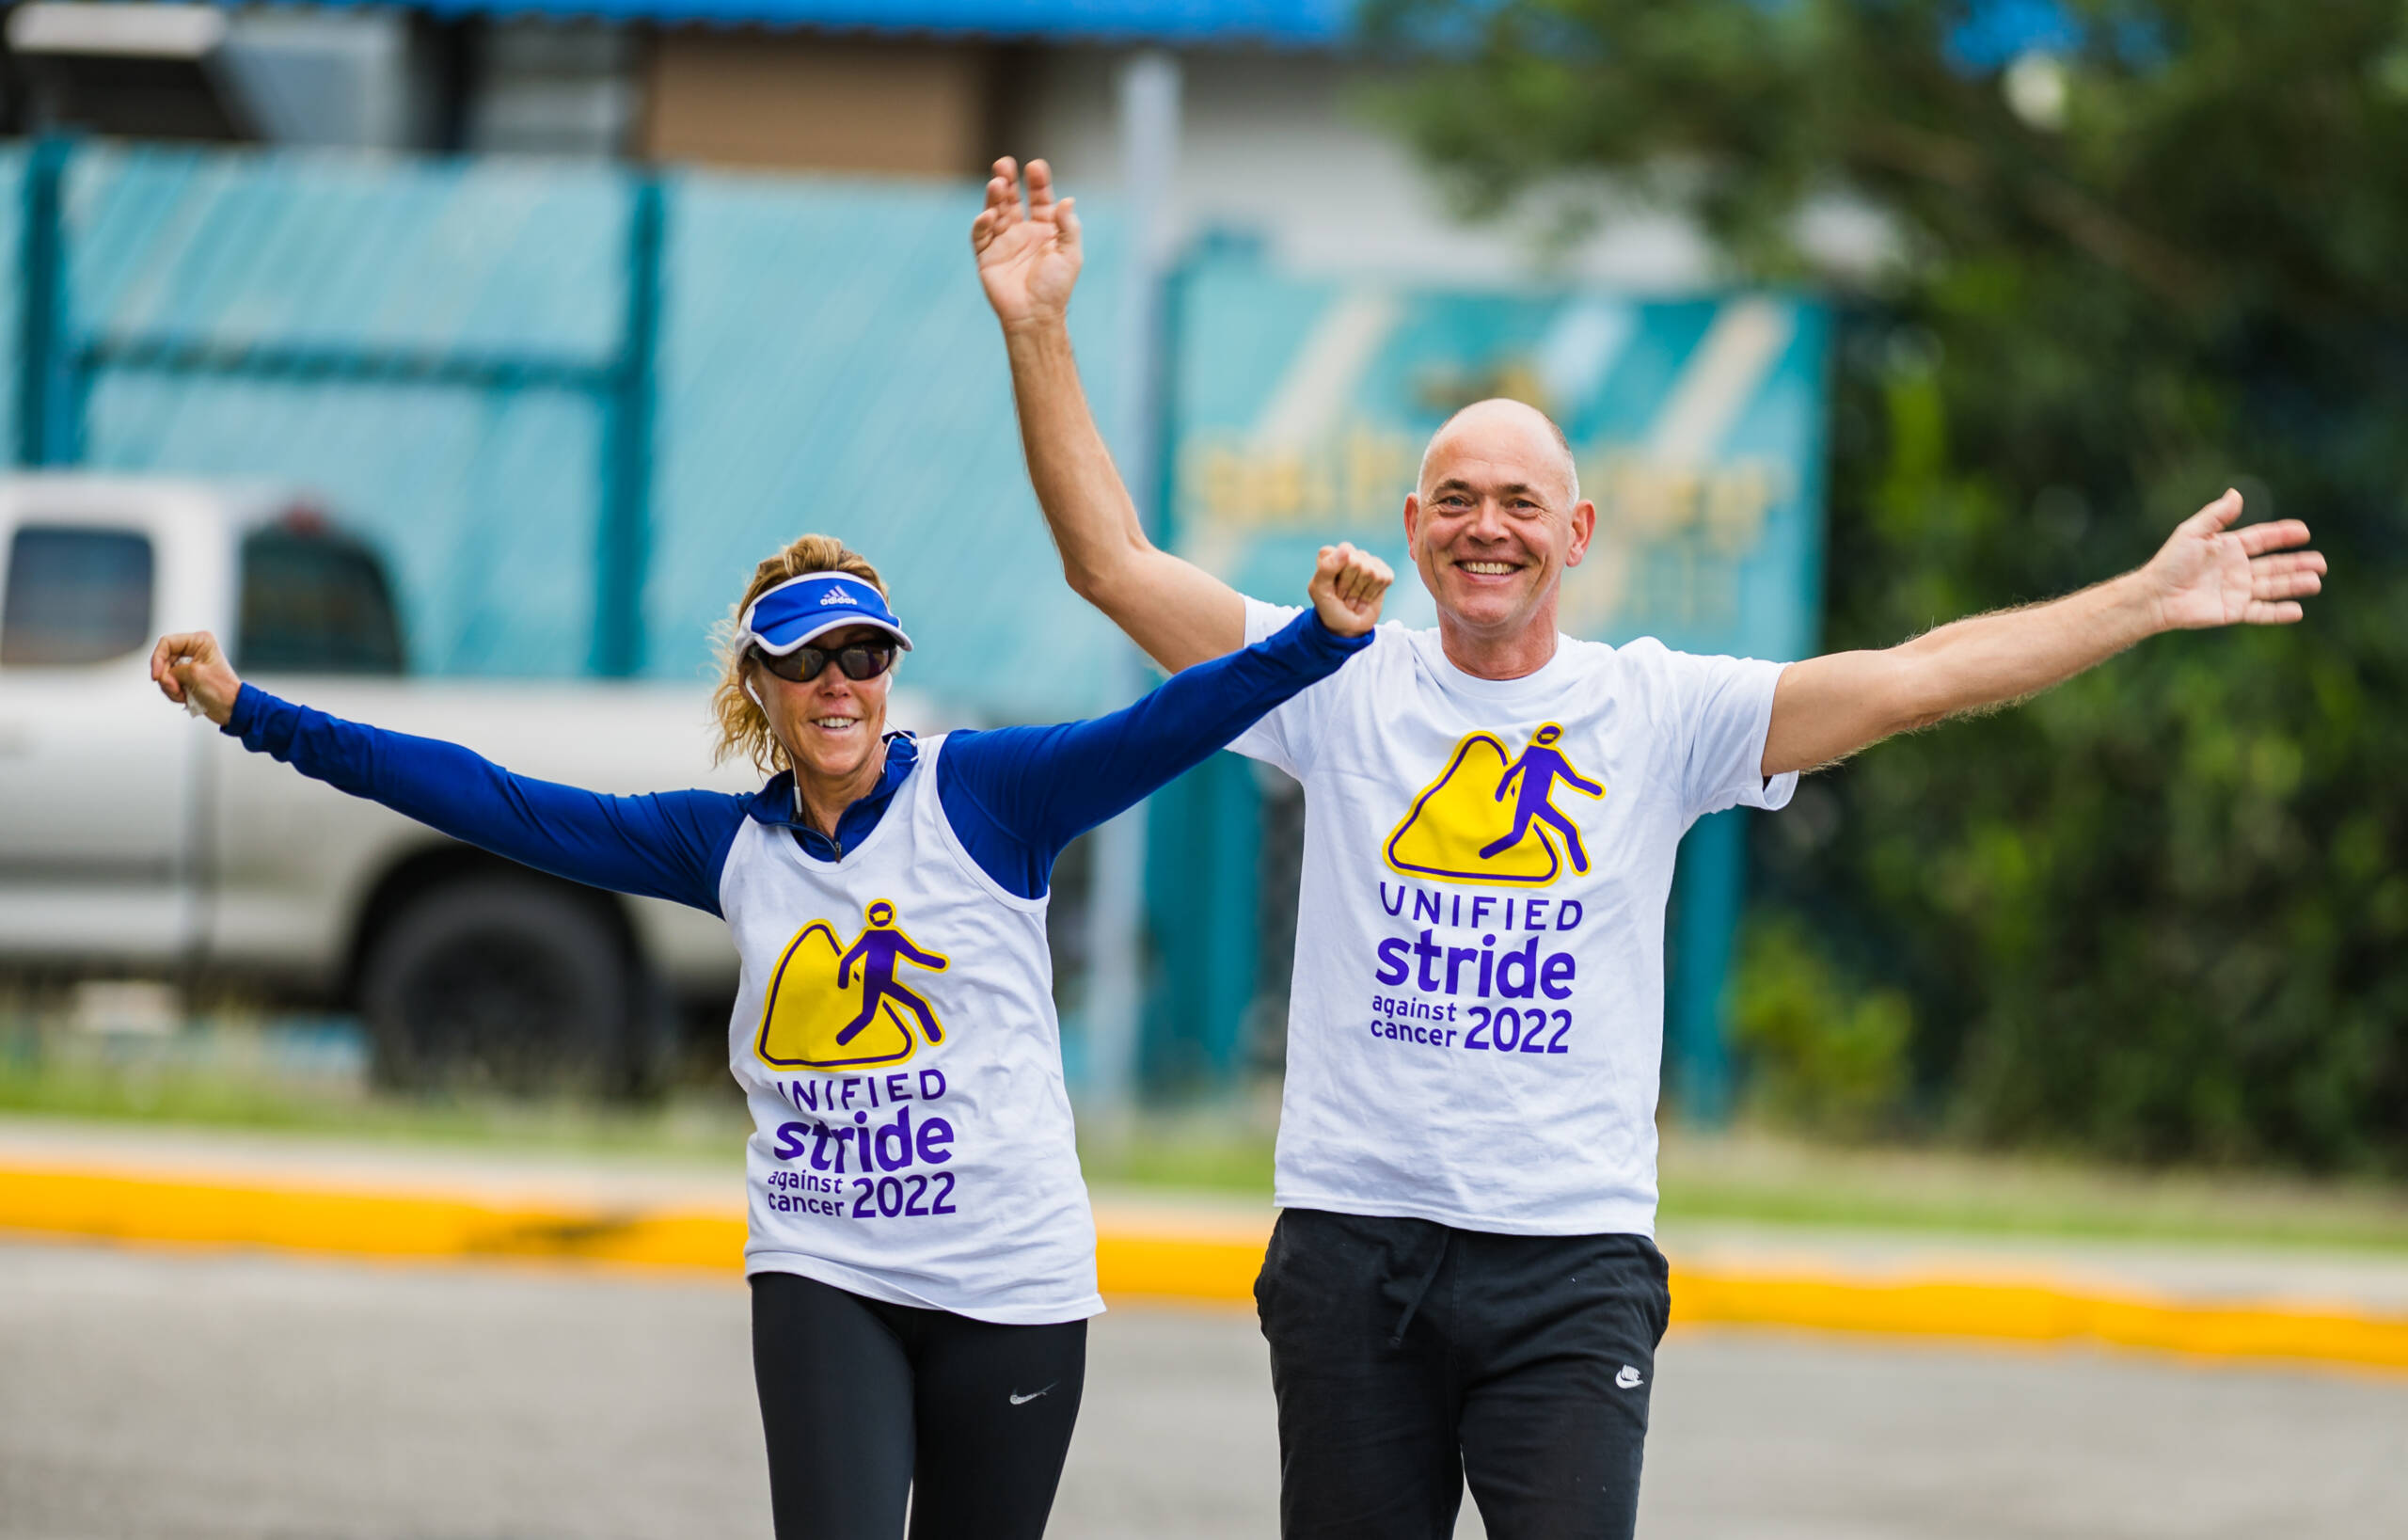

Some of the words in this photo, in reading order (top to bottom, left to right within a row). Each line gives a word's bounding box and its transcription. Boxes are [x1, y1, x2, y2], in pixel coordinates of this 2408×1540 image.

[819, 595, 858, 606] adidas
[1379, 881, 1583, 931] UNIFIED
[1375, 929, 1576, 1001] stride
[1370, 1019, 1458, 1048] cancer
[1464, 1006, 1573, 1054] 2022
[1371, 994, 1458, 1024] against
[773, 1104, 955, 1174] stride
[768, 1169, 844, 1195] against
[768, 1192, 845, 1217] cancer
[851, 1170, 957, 1219] 2022
